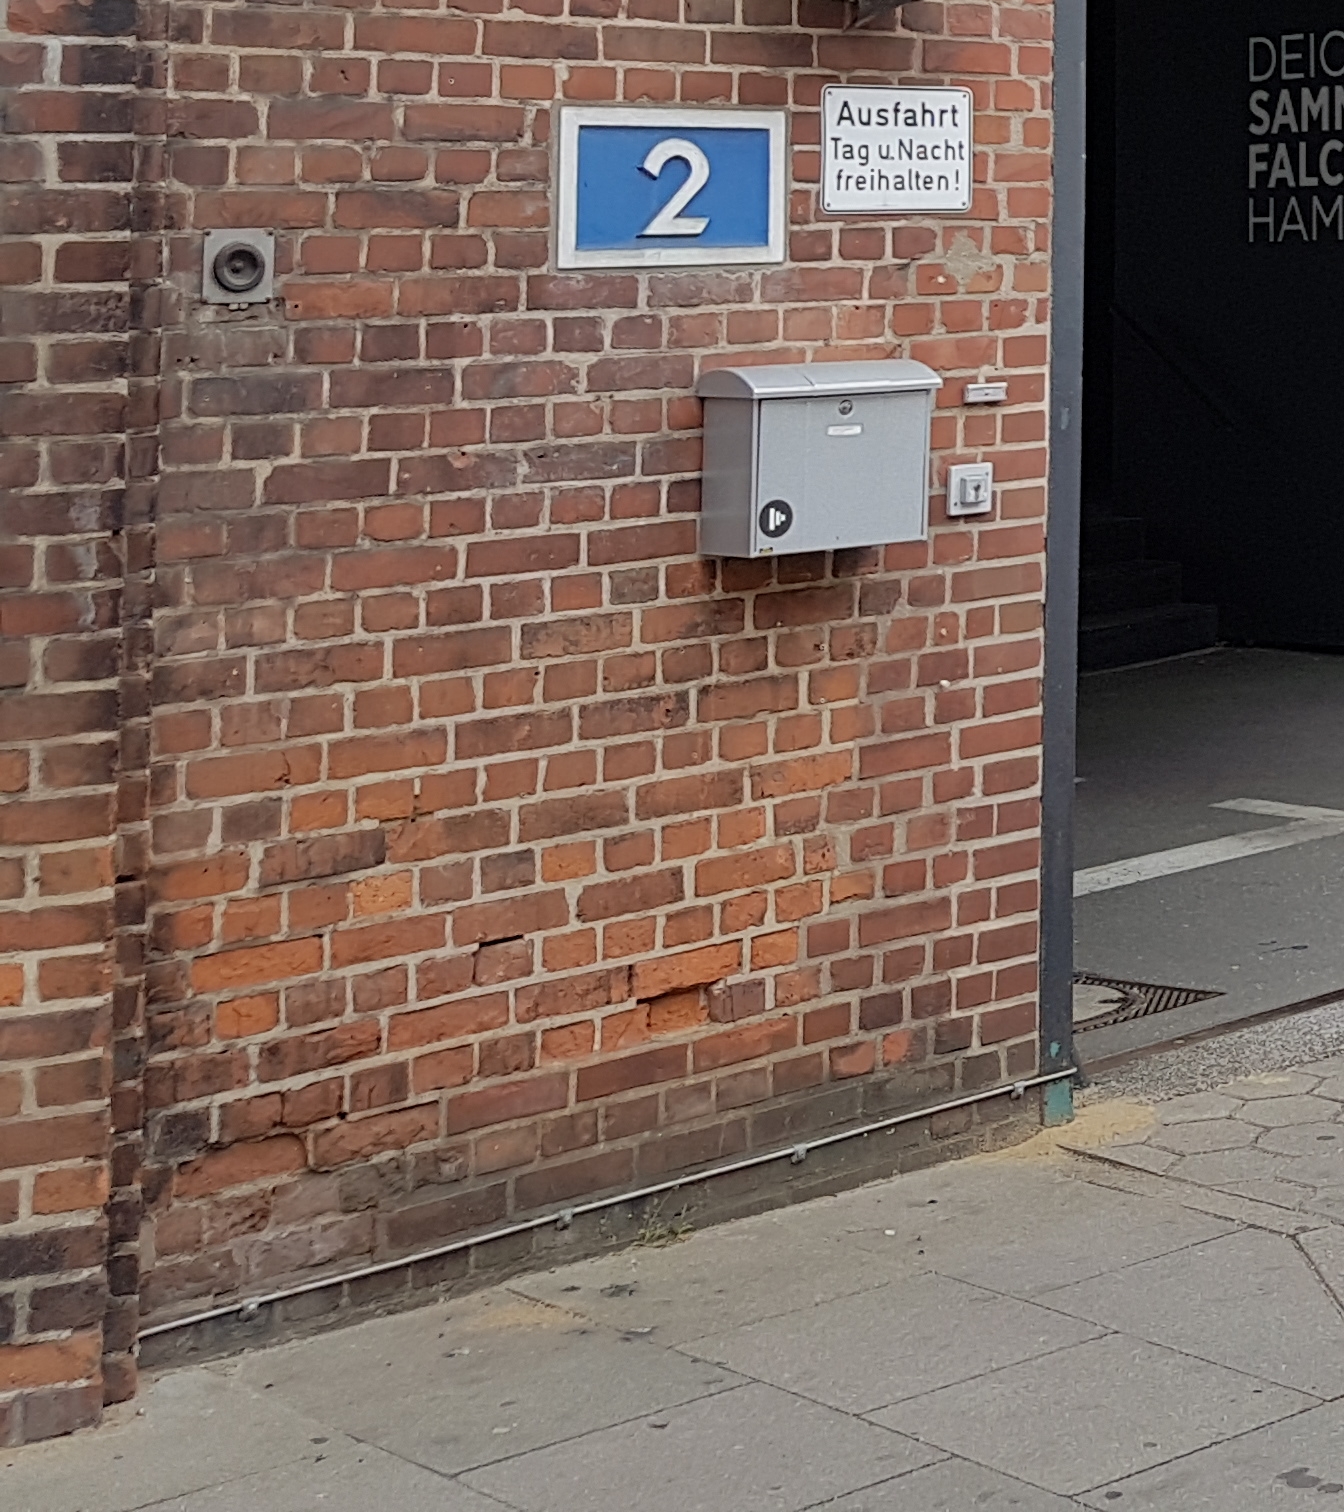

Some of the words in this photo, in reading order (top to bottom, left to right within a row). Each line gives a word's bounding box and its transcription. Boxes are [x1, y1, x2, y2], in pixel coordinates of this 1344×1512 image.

[836, 100, 959, 128] Ausfahrt
[831, 137, 869, 166] Tag
[636, 139, 711, 238] 2
[836, 168, 960, 191] freihalten!
